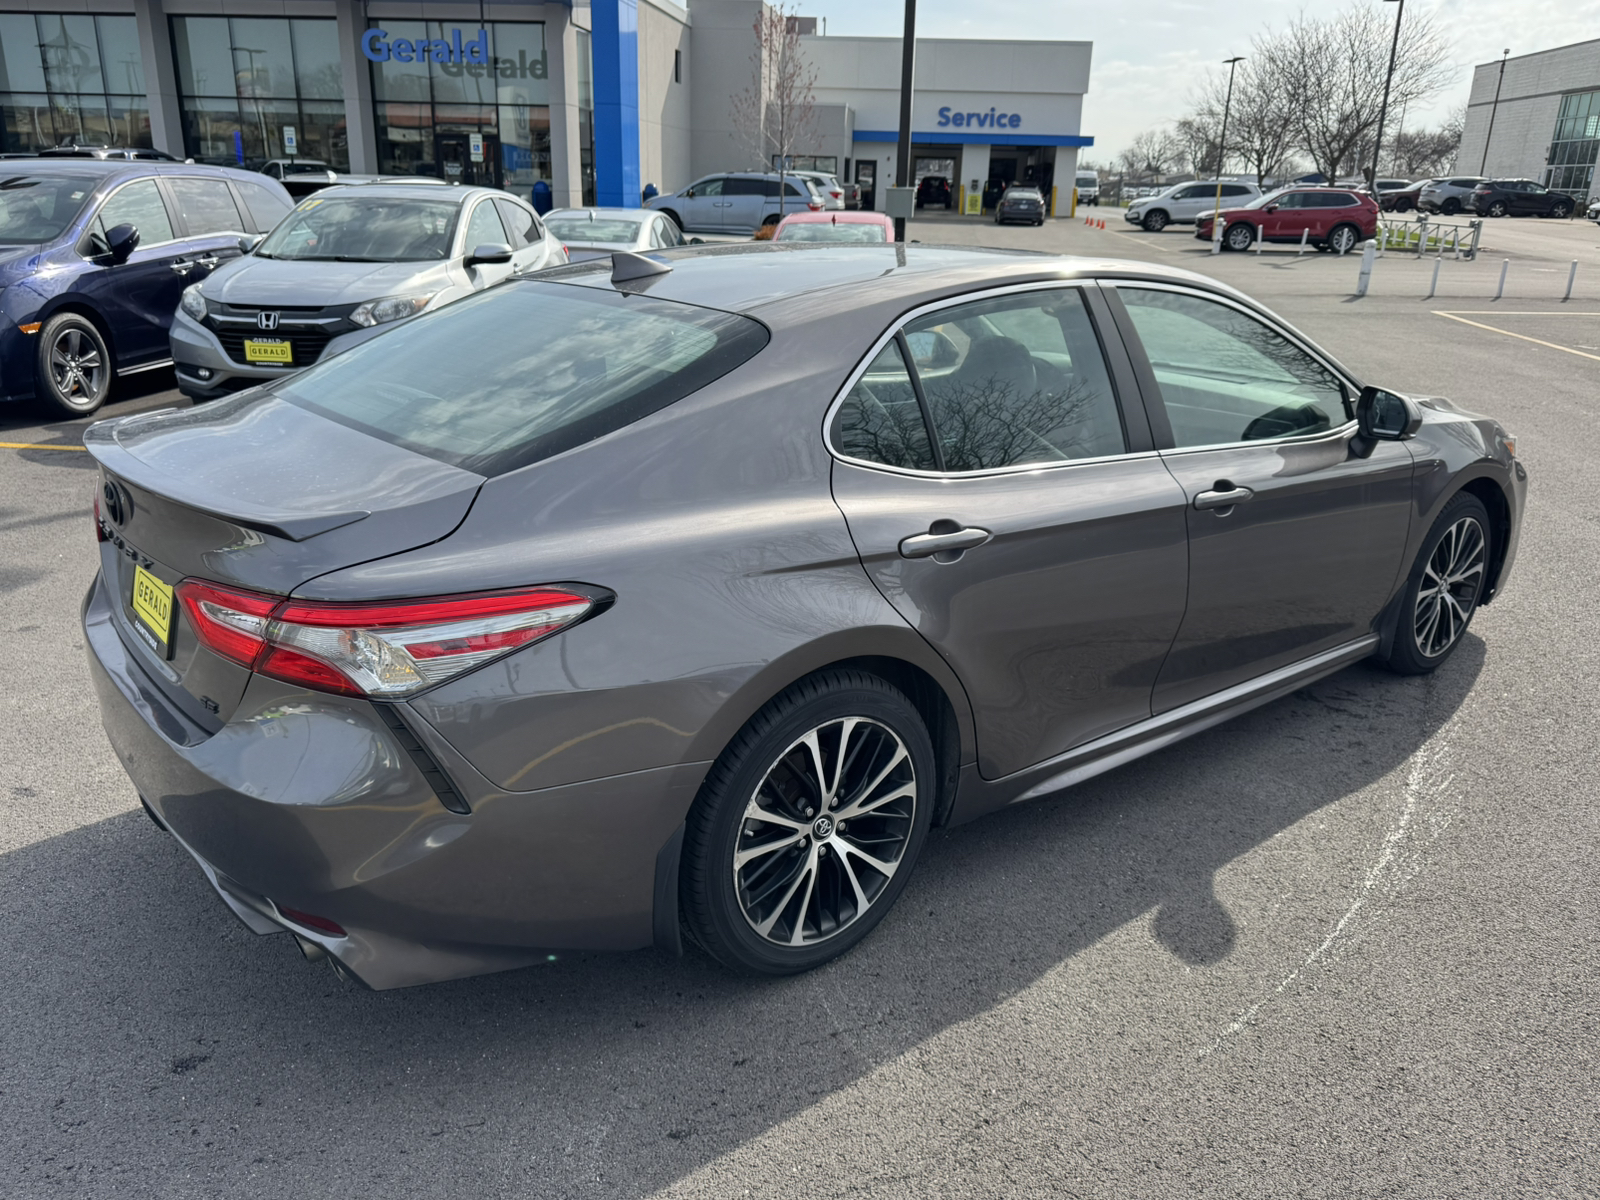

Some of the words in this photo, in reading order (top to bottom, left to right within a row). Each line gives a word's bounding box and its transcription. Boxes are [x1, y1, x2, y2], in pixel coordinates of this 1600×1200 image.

[361, 28, 489, 65] Gerald
[937, 106, 1022, 129] Service
[252, 347, 286, 356] GERALD
[138, 580, 168, 621] GERALD
